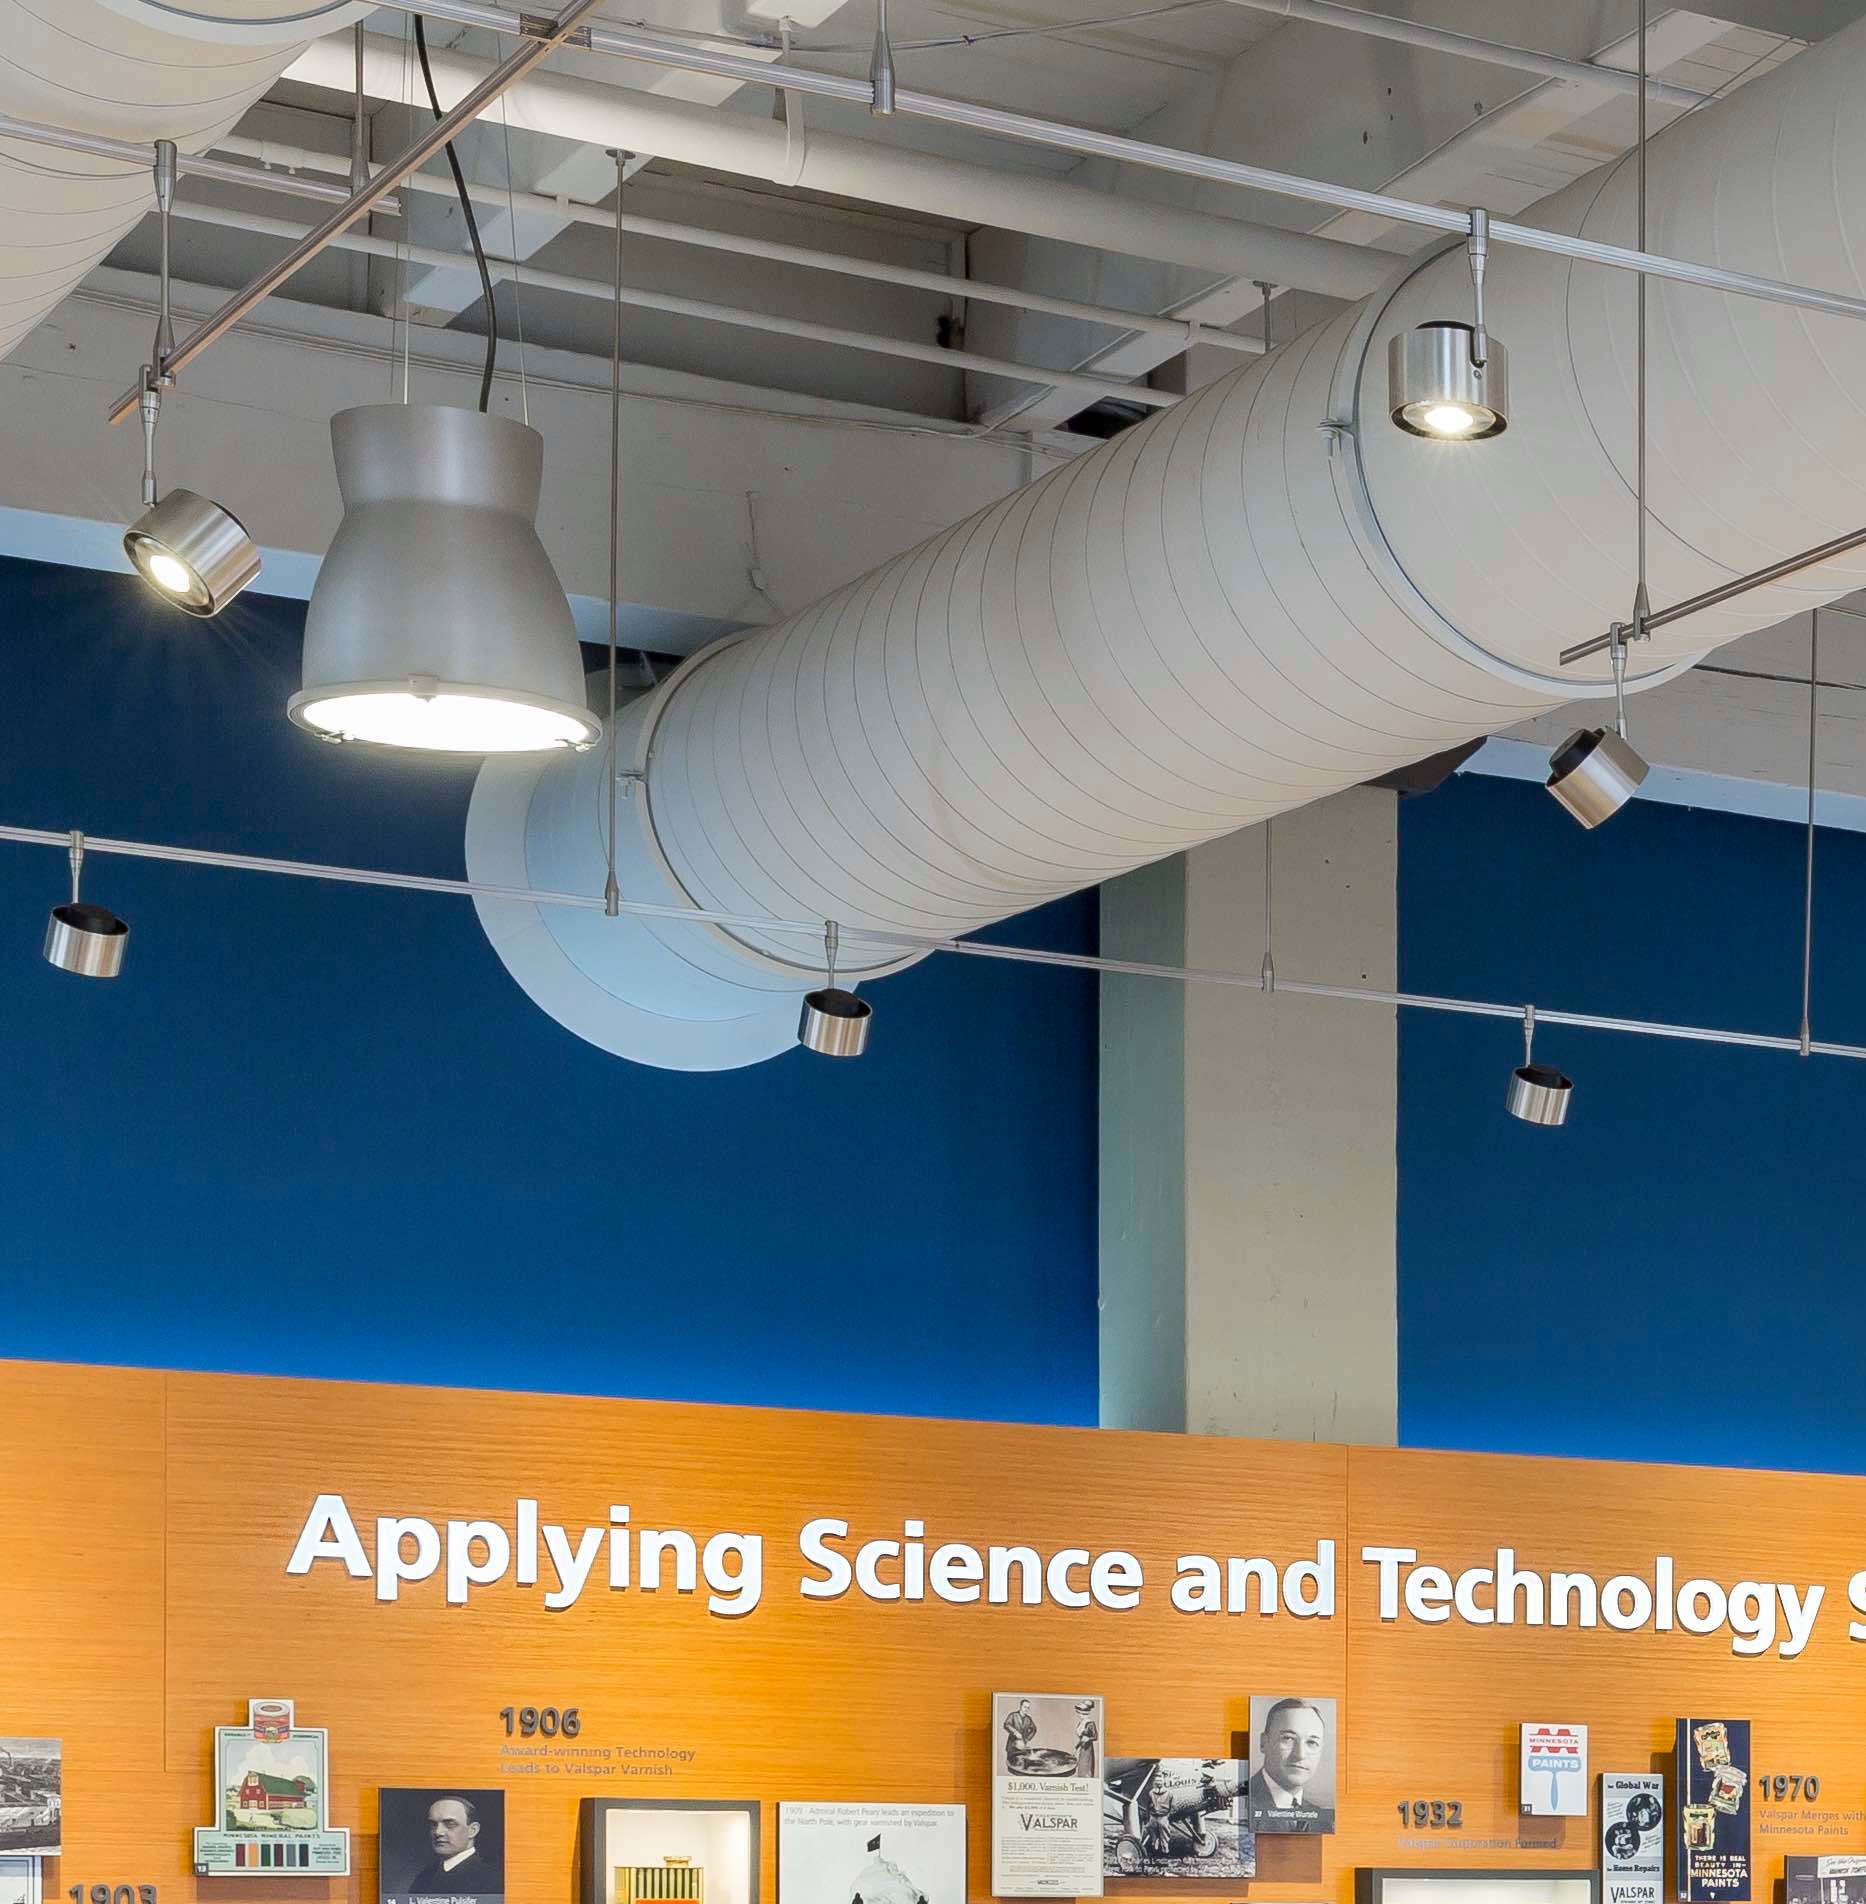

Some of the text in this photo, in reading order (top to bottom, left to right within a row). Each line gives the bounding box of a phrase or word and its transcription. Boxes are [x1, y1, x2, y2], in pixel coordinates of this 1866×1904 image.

[286, 1495, 763, 1616] Applying
[800, 1517, 1144, 1609] Science
[1171, 1539, 1336, 1620] and
[1361, 1546, 1826, 1657] Technology
[500, 1707, 580, 1737] 1906
[501, 1745, 695, 1761] Award-winning Technology
[500, 1762, 672, 1776] Leads to Valspar Varnish
[1532, 1760, 1579, 1768] PAINTS
[1616, 1781, 1659, 1790] Global War
[1759, 1776, 1820, 1802] 1970
[1398, 1801, 1463, 1828] 1932
[1760, 1810, 1865, 1822] Valspar Merges with
[1020, 1815, 1078, 1831] VALSPAR
[1760, 1824, 1849, 1835] Minnesota Paints
[1613, 1864, 1660, 1873] Home Repairs
[1691, 1869, 1748, 1878] MINNESOTA
[1701, 1878, 1739, 1888] PAINTS
[1610, 1886, 1655, 1903] VALSPAR
